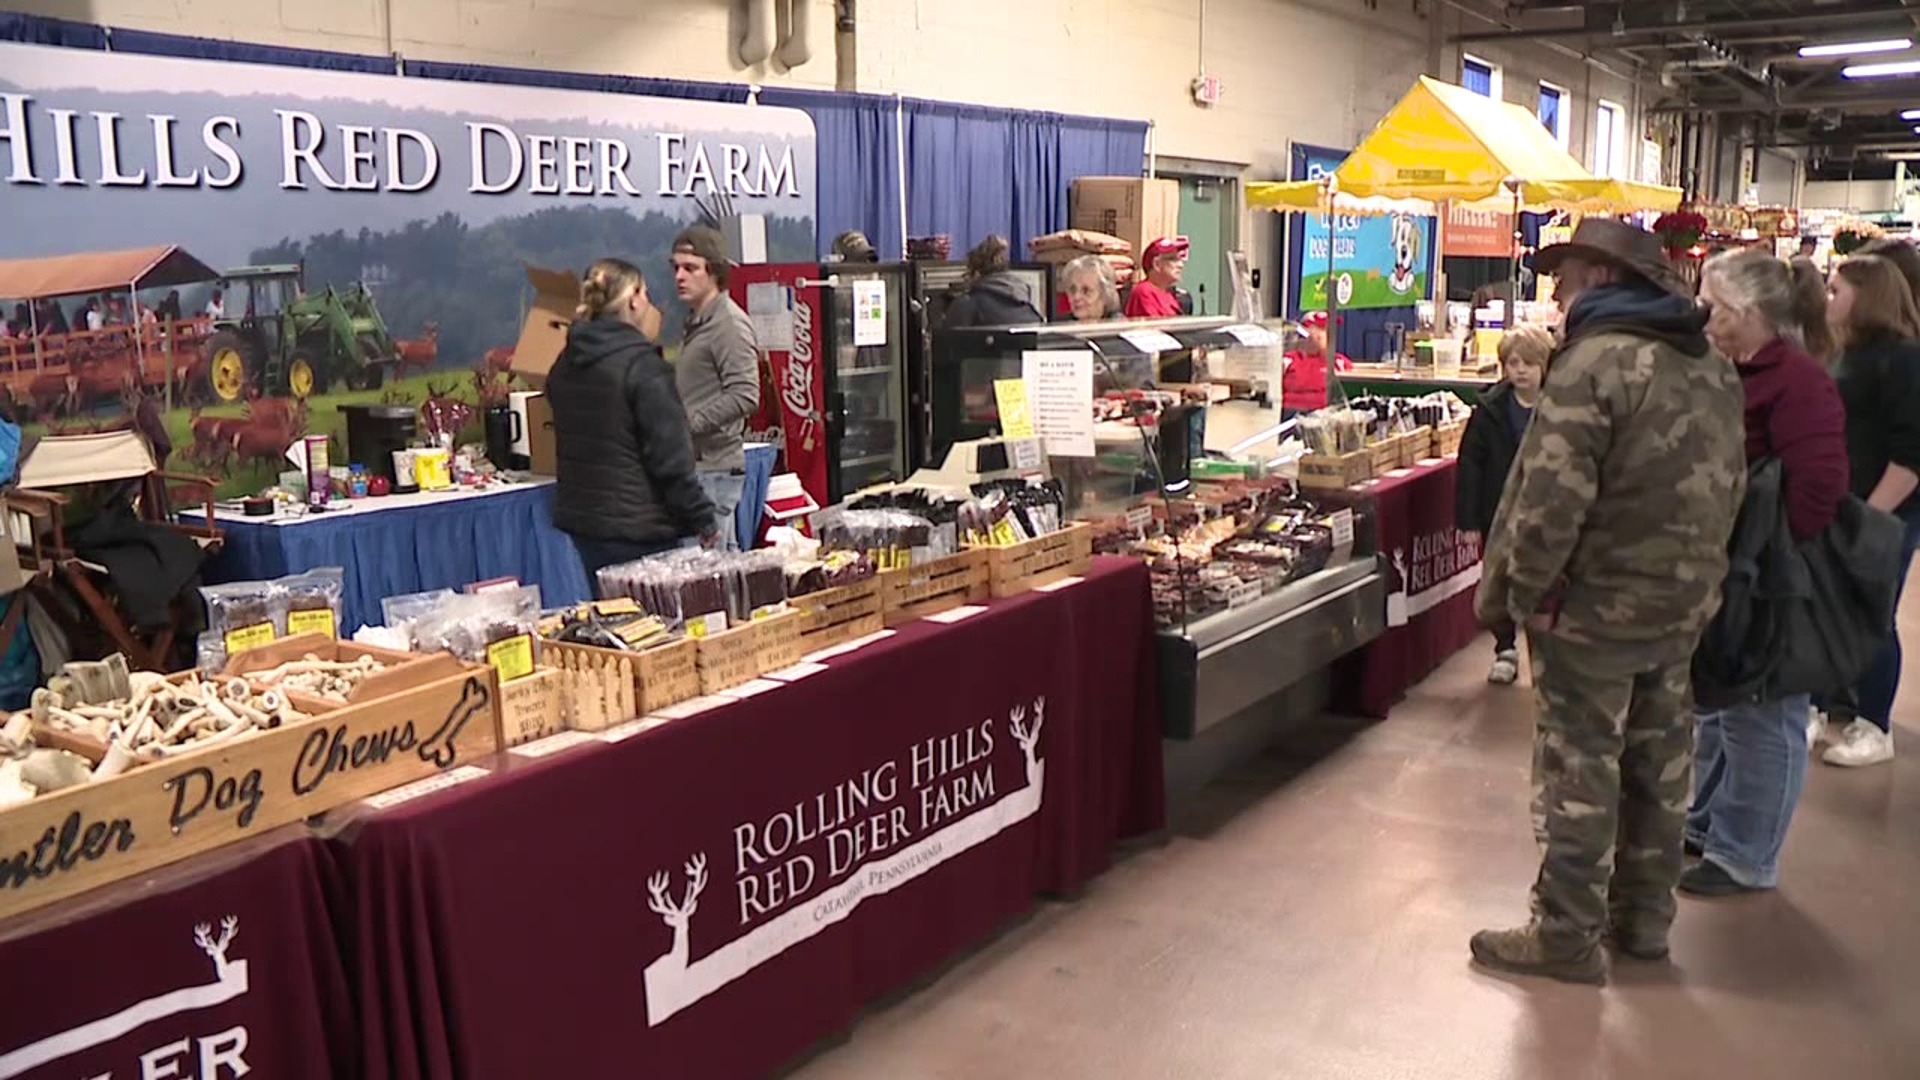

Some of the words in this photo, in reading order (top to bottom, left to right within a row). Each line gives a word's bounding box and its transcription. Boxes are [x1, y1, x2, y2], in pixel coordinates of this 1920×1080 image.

[274, 108, 438, 193] RED
[466, 121, 640, 197] DEER
[655, 131, 801, 198] FARM
[0, 811, 135, 889] ntler
[163, 767, 263, 828] Dog
[293, 720, 418, 796] Chews
[733, 760, 898, 875] ROLLING
[909, 718, 995, 789] HILLS
[735, 853, 816, 926] RED
[826, 804, 912, 881] DEER
[919, 763, 997, 832] FARM
